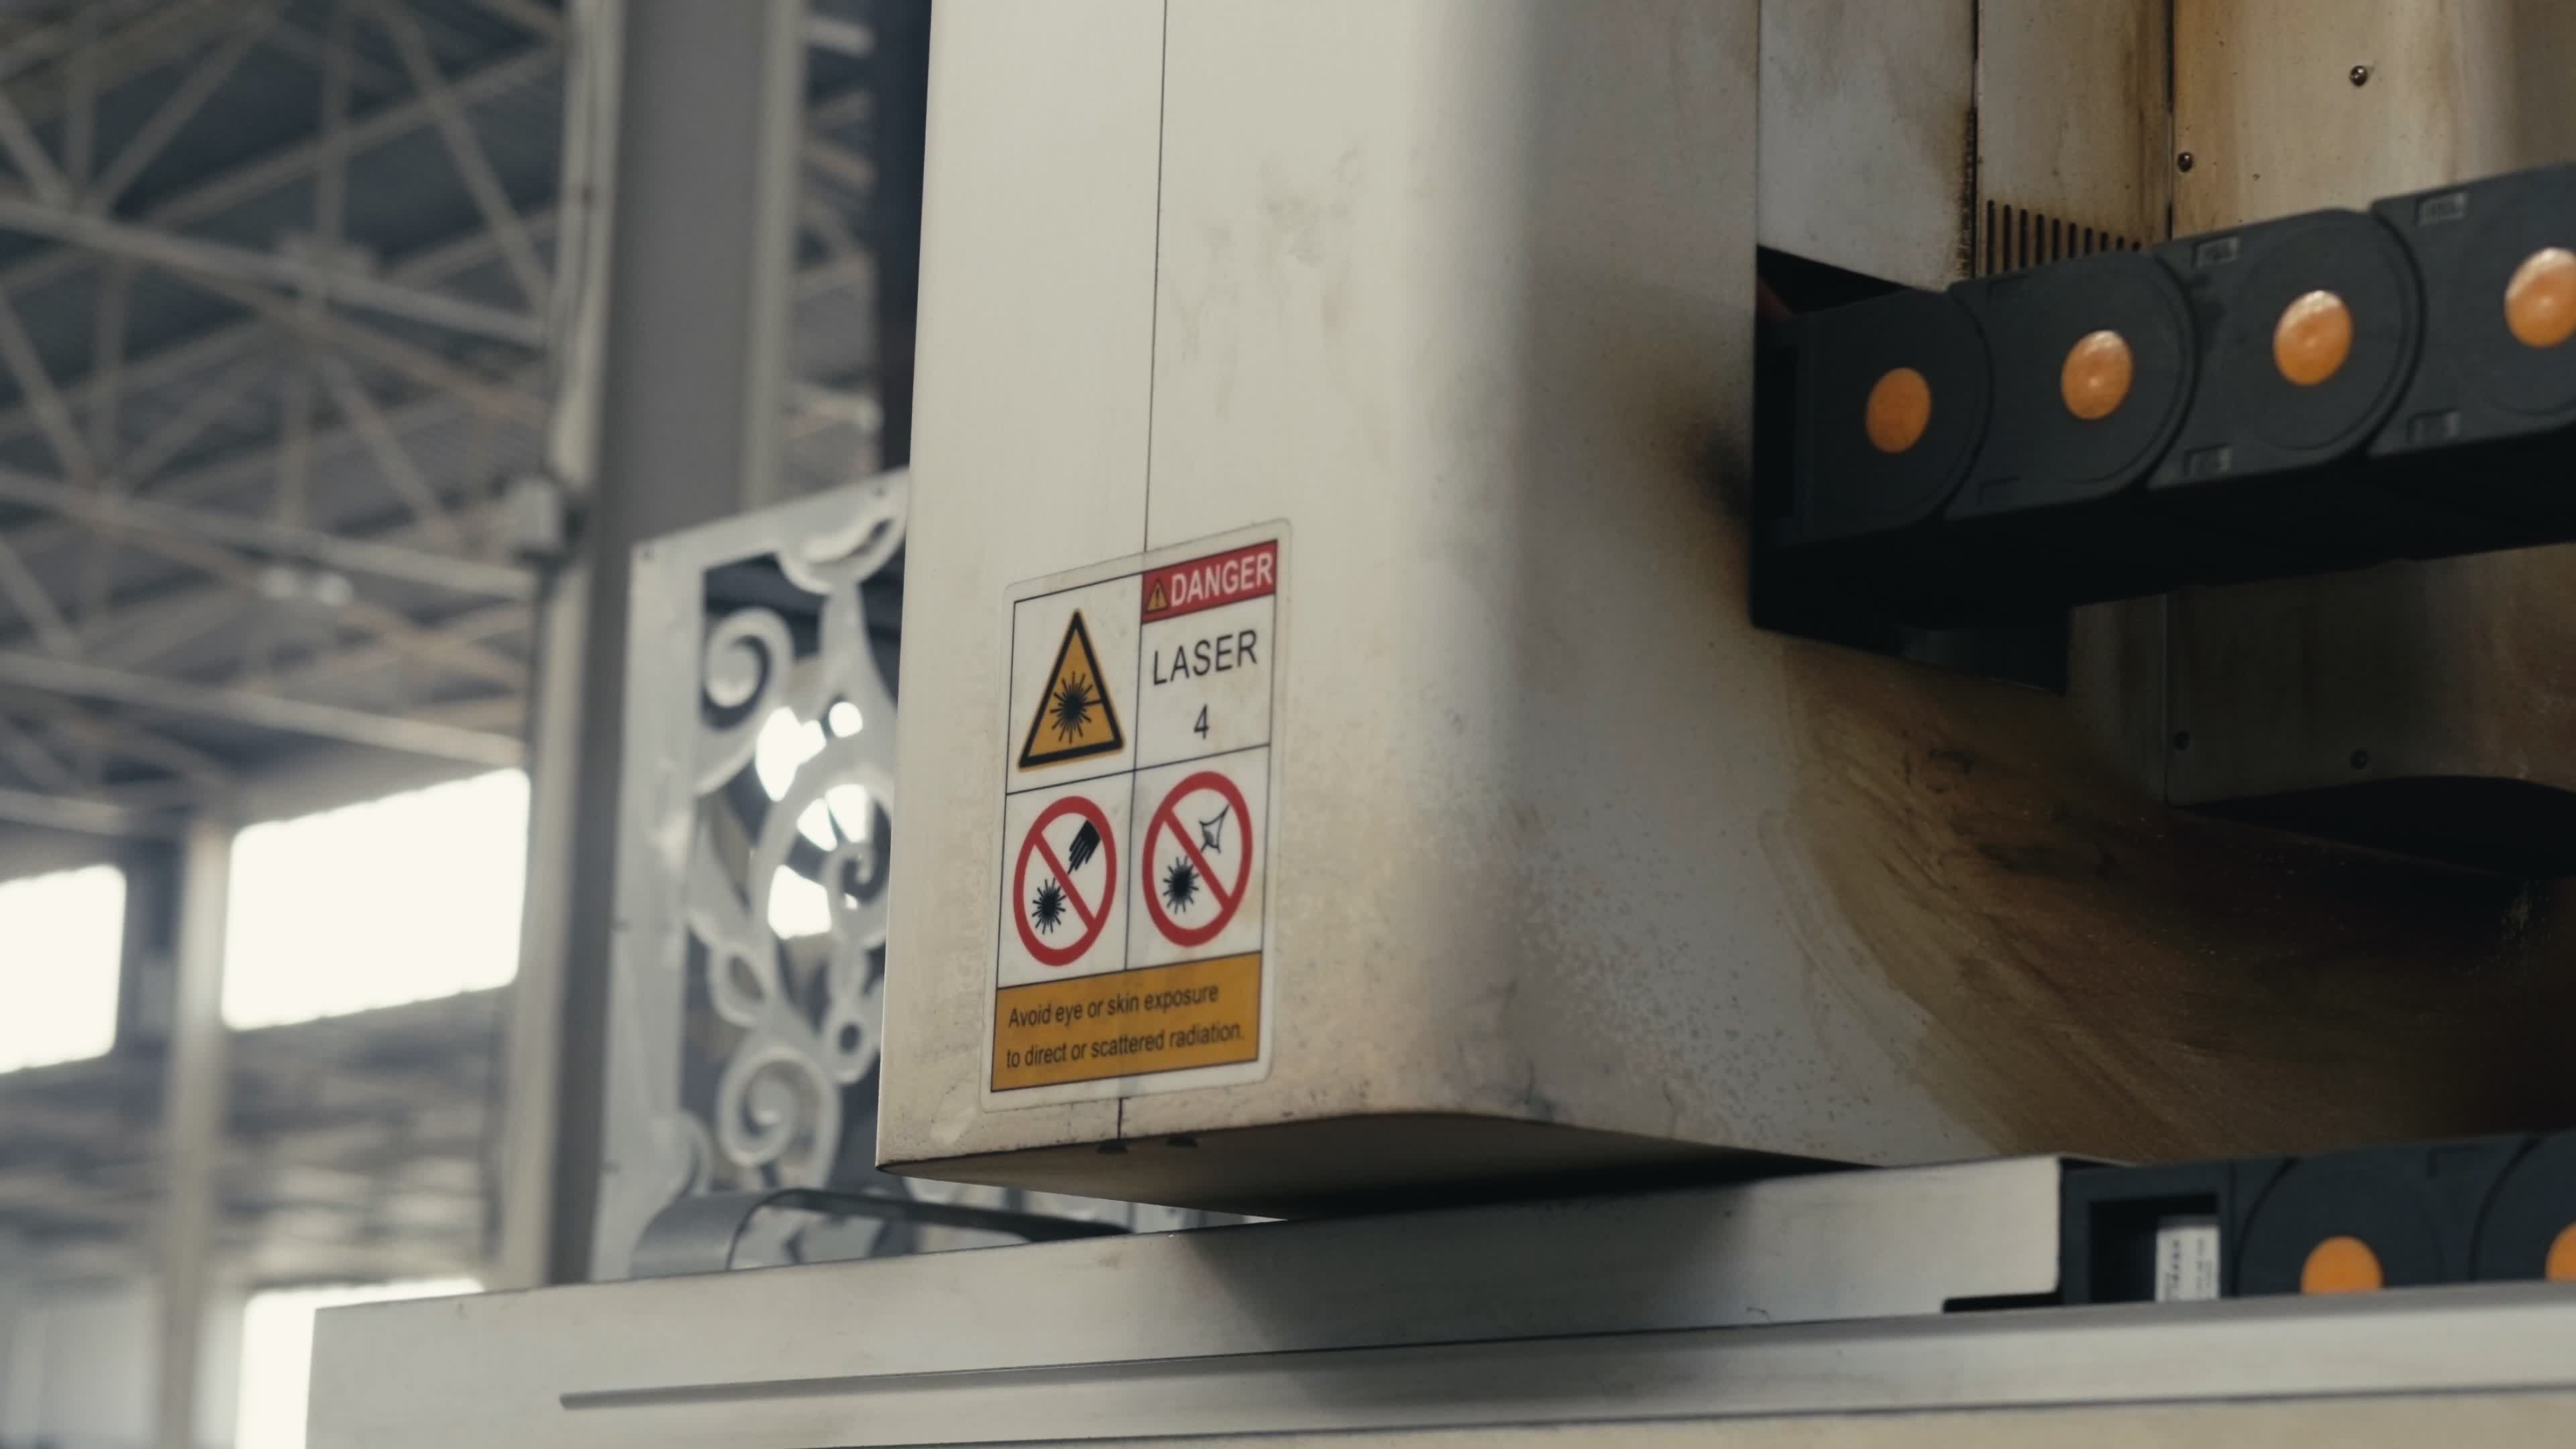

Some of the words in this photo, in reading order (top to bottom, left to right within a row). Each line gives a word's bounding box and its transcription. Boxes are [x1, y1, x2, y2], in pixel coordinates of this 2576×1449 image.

[1171, 552, 1273, 607] DANGER
[1152, 629, 1258, 686] LASER
[1193, 704, 1210, 739] 4
[1008, 1004, 1051, 1028] Avoid
[1055, 1003, 1083, 1027] eye
[1087, 1000, 1104, 1018] or
[1108, 992, 1138, 1016] skin
[1144, 985, 1218, 1014] exposure
[1007, 1049, 1020, 1069] to
[1025, 1042, 1067, 1066] direct
[1071, 1042, 1087, 1060] or
[1091, 1029, 1165, 1058] scattered
[1169, 1021, 1244, 1047] radiation.
